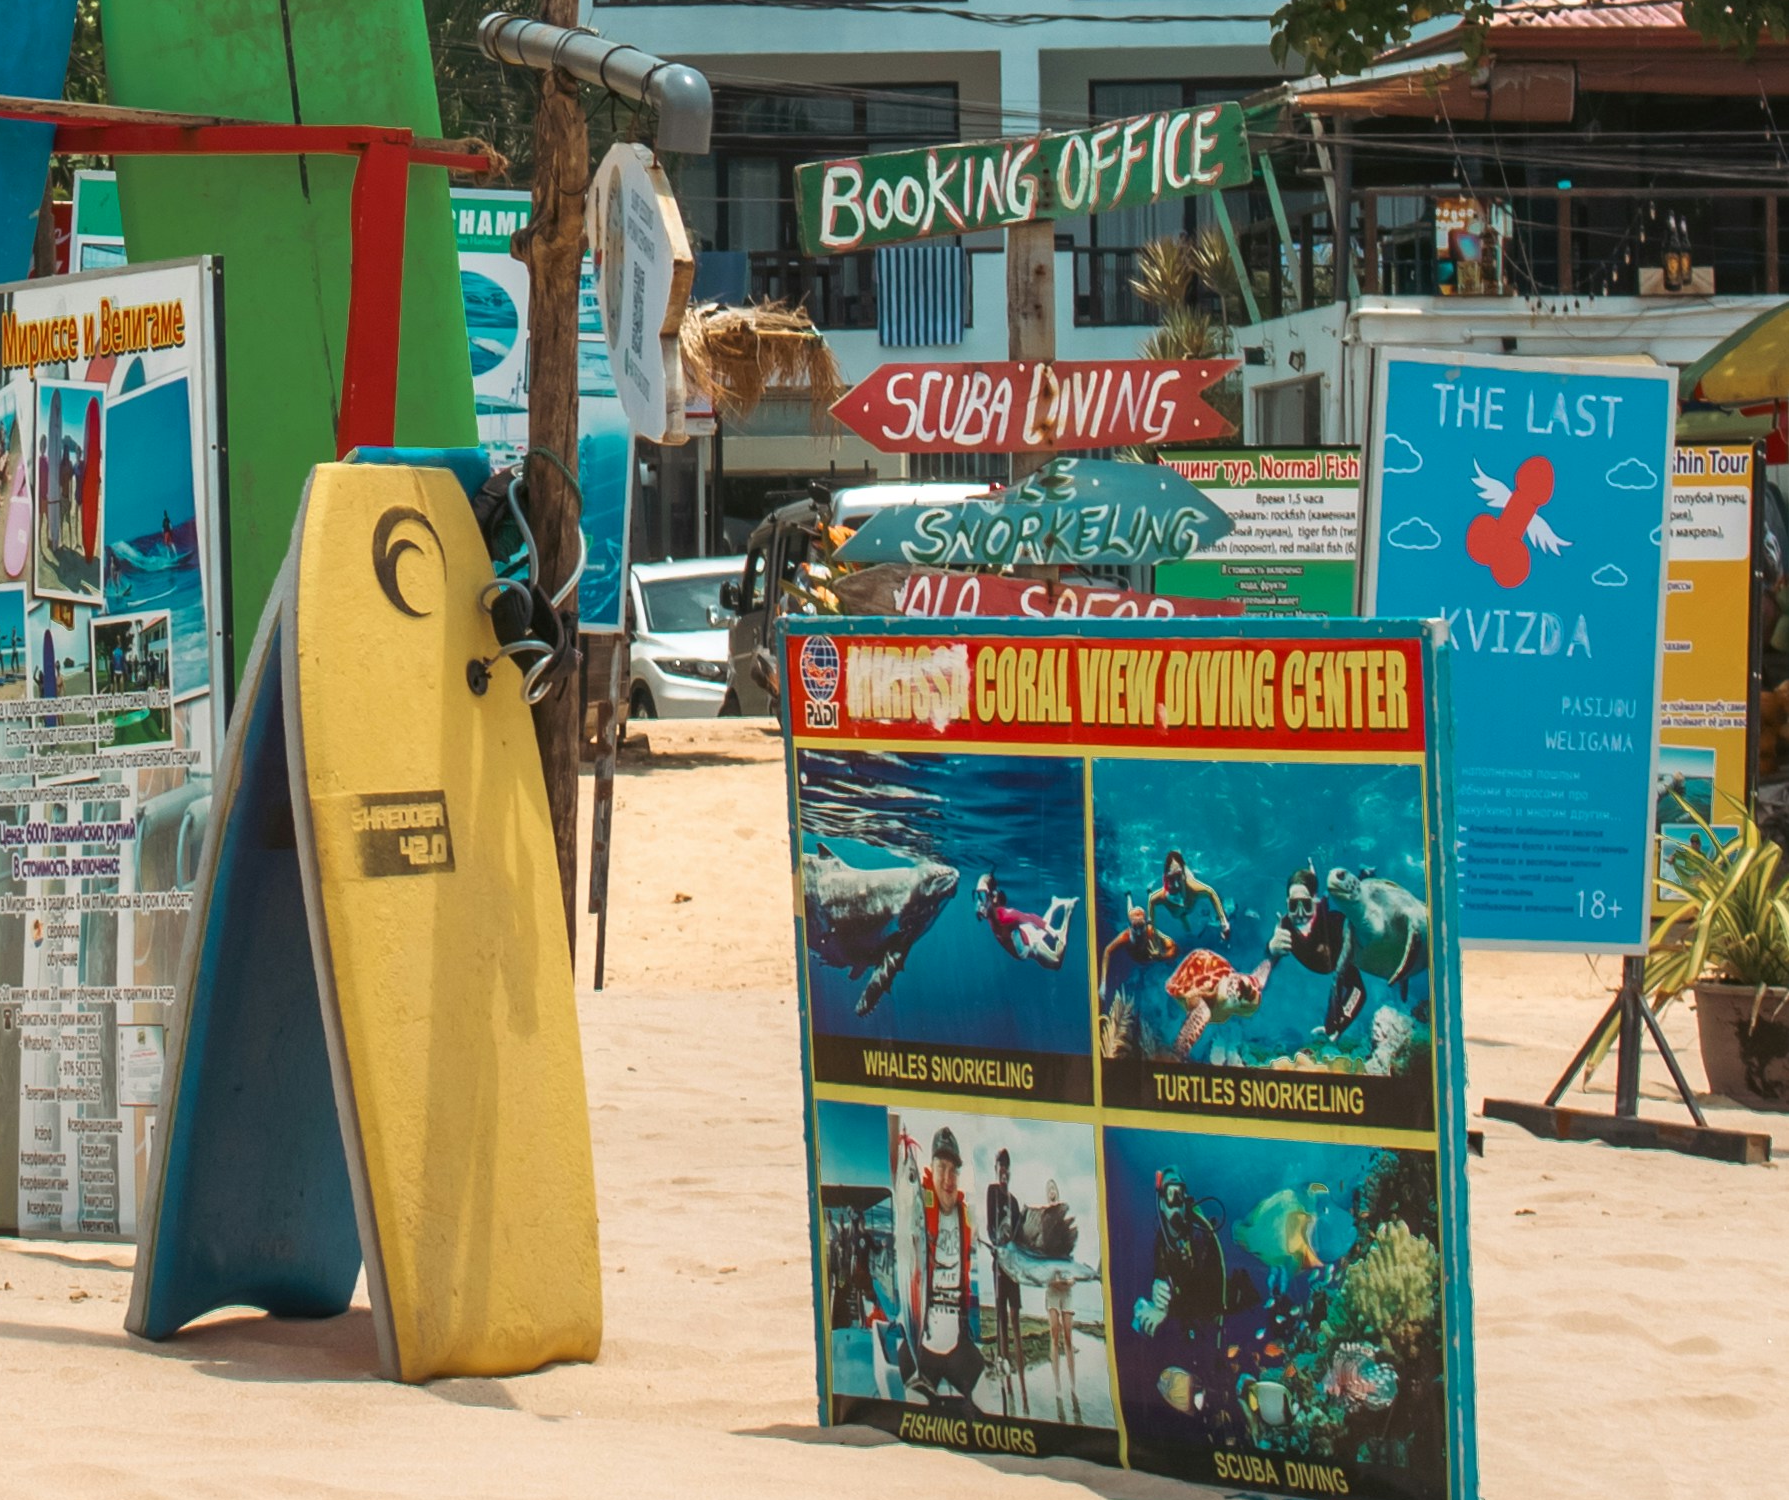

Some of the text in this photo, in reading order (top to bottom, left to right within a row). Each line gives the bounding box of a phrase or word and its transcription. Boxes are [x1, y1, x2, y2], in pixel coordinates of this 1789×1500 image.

[819, 103, 1224, 249] BOOKING OFFICE
[2, 310, 78, 379] Мириссе
[83, 312, 95, 356] и
[99, 297, 185, 354] Велигаме
[881, 362, 1182, 446] SCUBA DIVING
[1433, 383, 1623, 440] THE LAST
[1223, 461, 1256, 485] тур.
[1261, 453, 1321, 480] Normal
[1708, 449, 1749, 475] Tour
[1256, 493, 1324, 507] Время 1,5 часа
[1673, 491, 1714, 506] голубой
[1271, 509, 1306, 521] rockfish
[899, 503, 1210, 565] SNORKELING
[1298, 528, 1319, 539] tiger
[1322, 526, 1337, 537] fish
[1280, 542, 1294, 553] red
[1327, 541, 1342, 553] fish
[976, 645, 1073, 723] CORAL
[1078, 647, 1163, 726] VIEW
[1163, 649, 1275, 730] DIVING
[1281, 649, 1409, 731] CENTER
[806, 703, 839, 727] PADI
[1544, 729, 1634, 752] WELIGAMA
[16, 757, 27, 774] and
[1505, 787, 1564, 799] вопросами
[352, 802, 445, 831] SHREDDER
[26, 822, 48, 844] 6000
[50, 821, 105, 843] ланкийских
[106, 818, 136, 846] рупий
[399, 834, 448, 865] 42.0
[13, 856, 21, 878] В
[22, 858, 70, 878] стоимость
[1576, 889, 1623, 919] 18+
[46, 921, 80, 942] сёрфборд
[46, 950, 78, 967] обучение
[24, 1035, 52, 1053] WhatsApp
[863, 1049, 1034, 1090] WHALES SNORKELING
[1153, 1073, 1364, 1115] TURTLES SNORKELING
[899, 1411, 1038, 1455] FISHING TOURS
[1213, 1452, 1350, 1496] SCUBA DIVING
